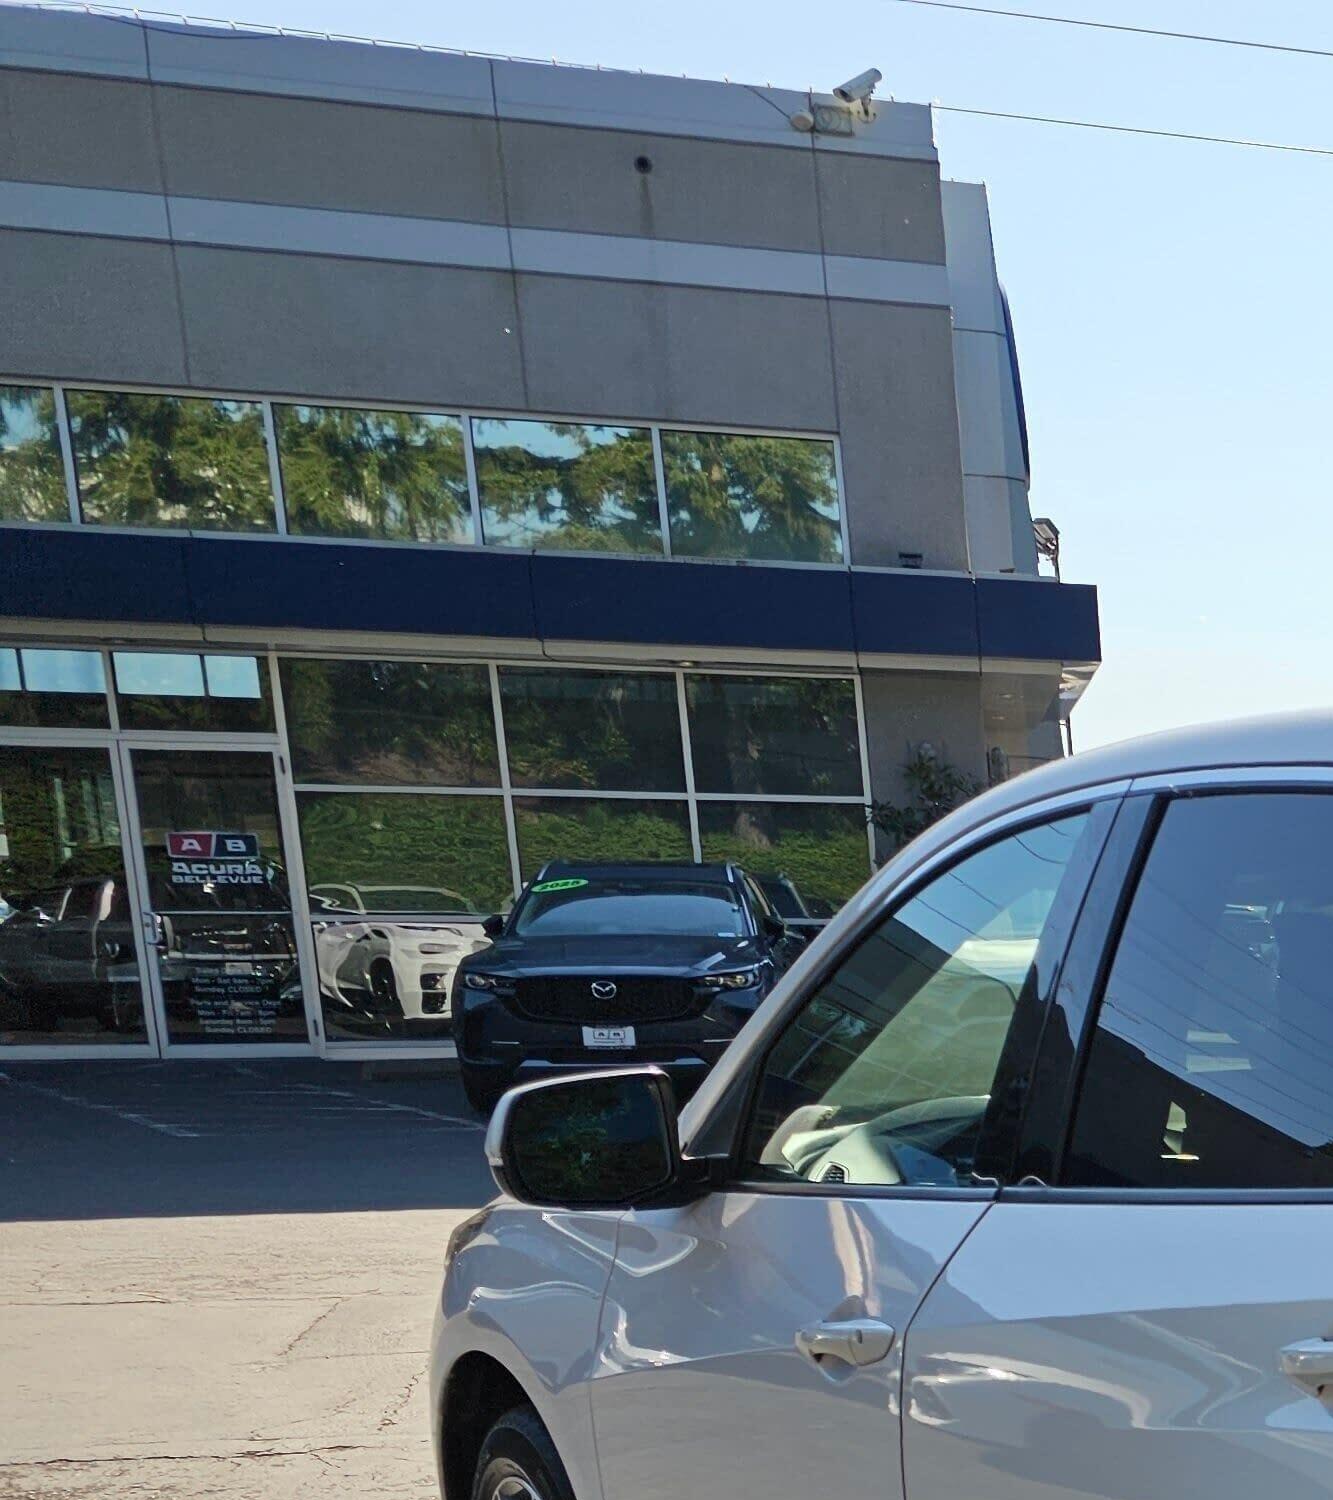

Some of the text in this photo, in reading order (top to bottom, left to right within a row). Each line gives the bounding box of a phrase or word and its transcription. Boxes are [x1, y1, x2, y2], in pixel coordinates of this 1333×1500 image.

[180, 838, 247, 852] A B
[172, 874, 264, 884] BELLEVUE
